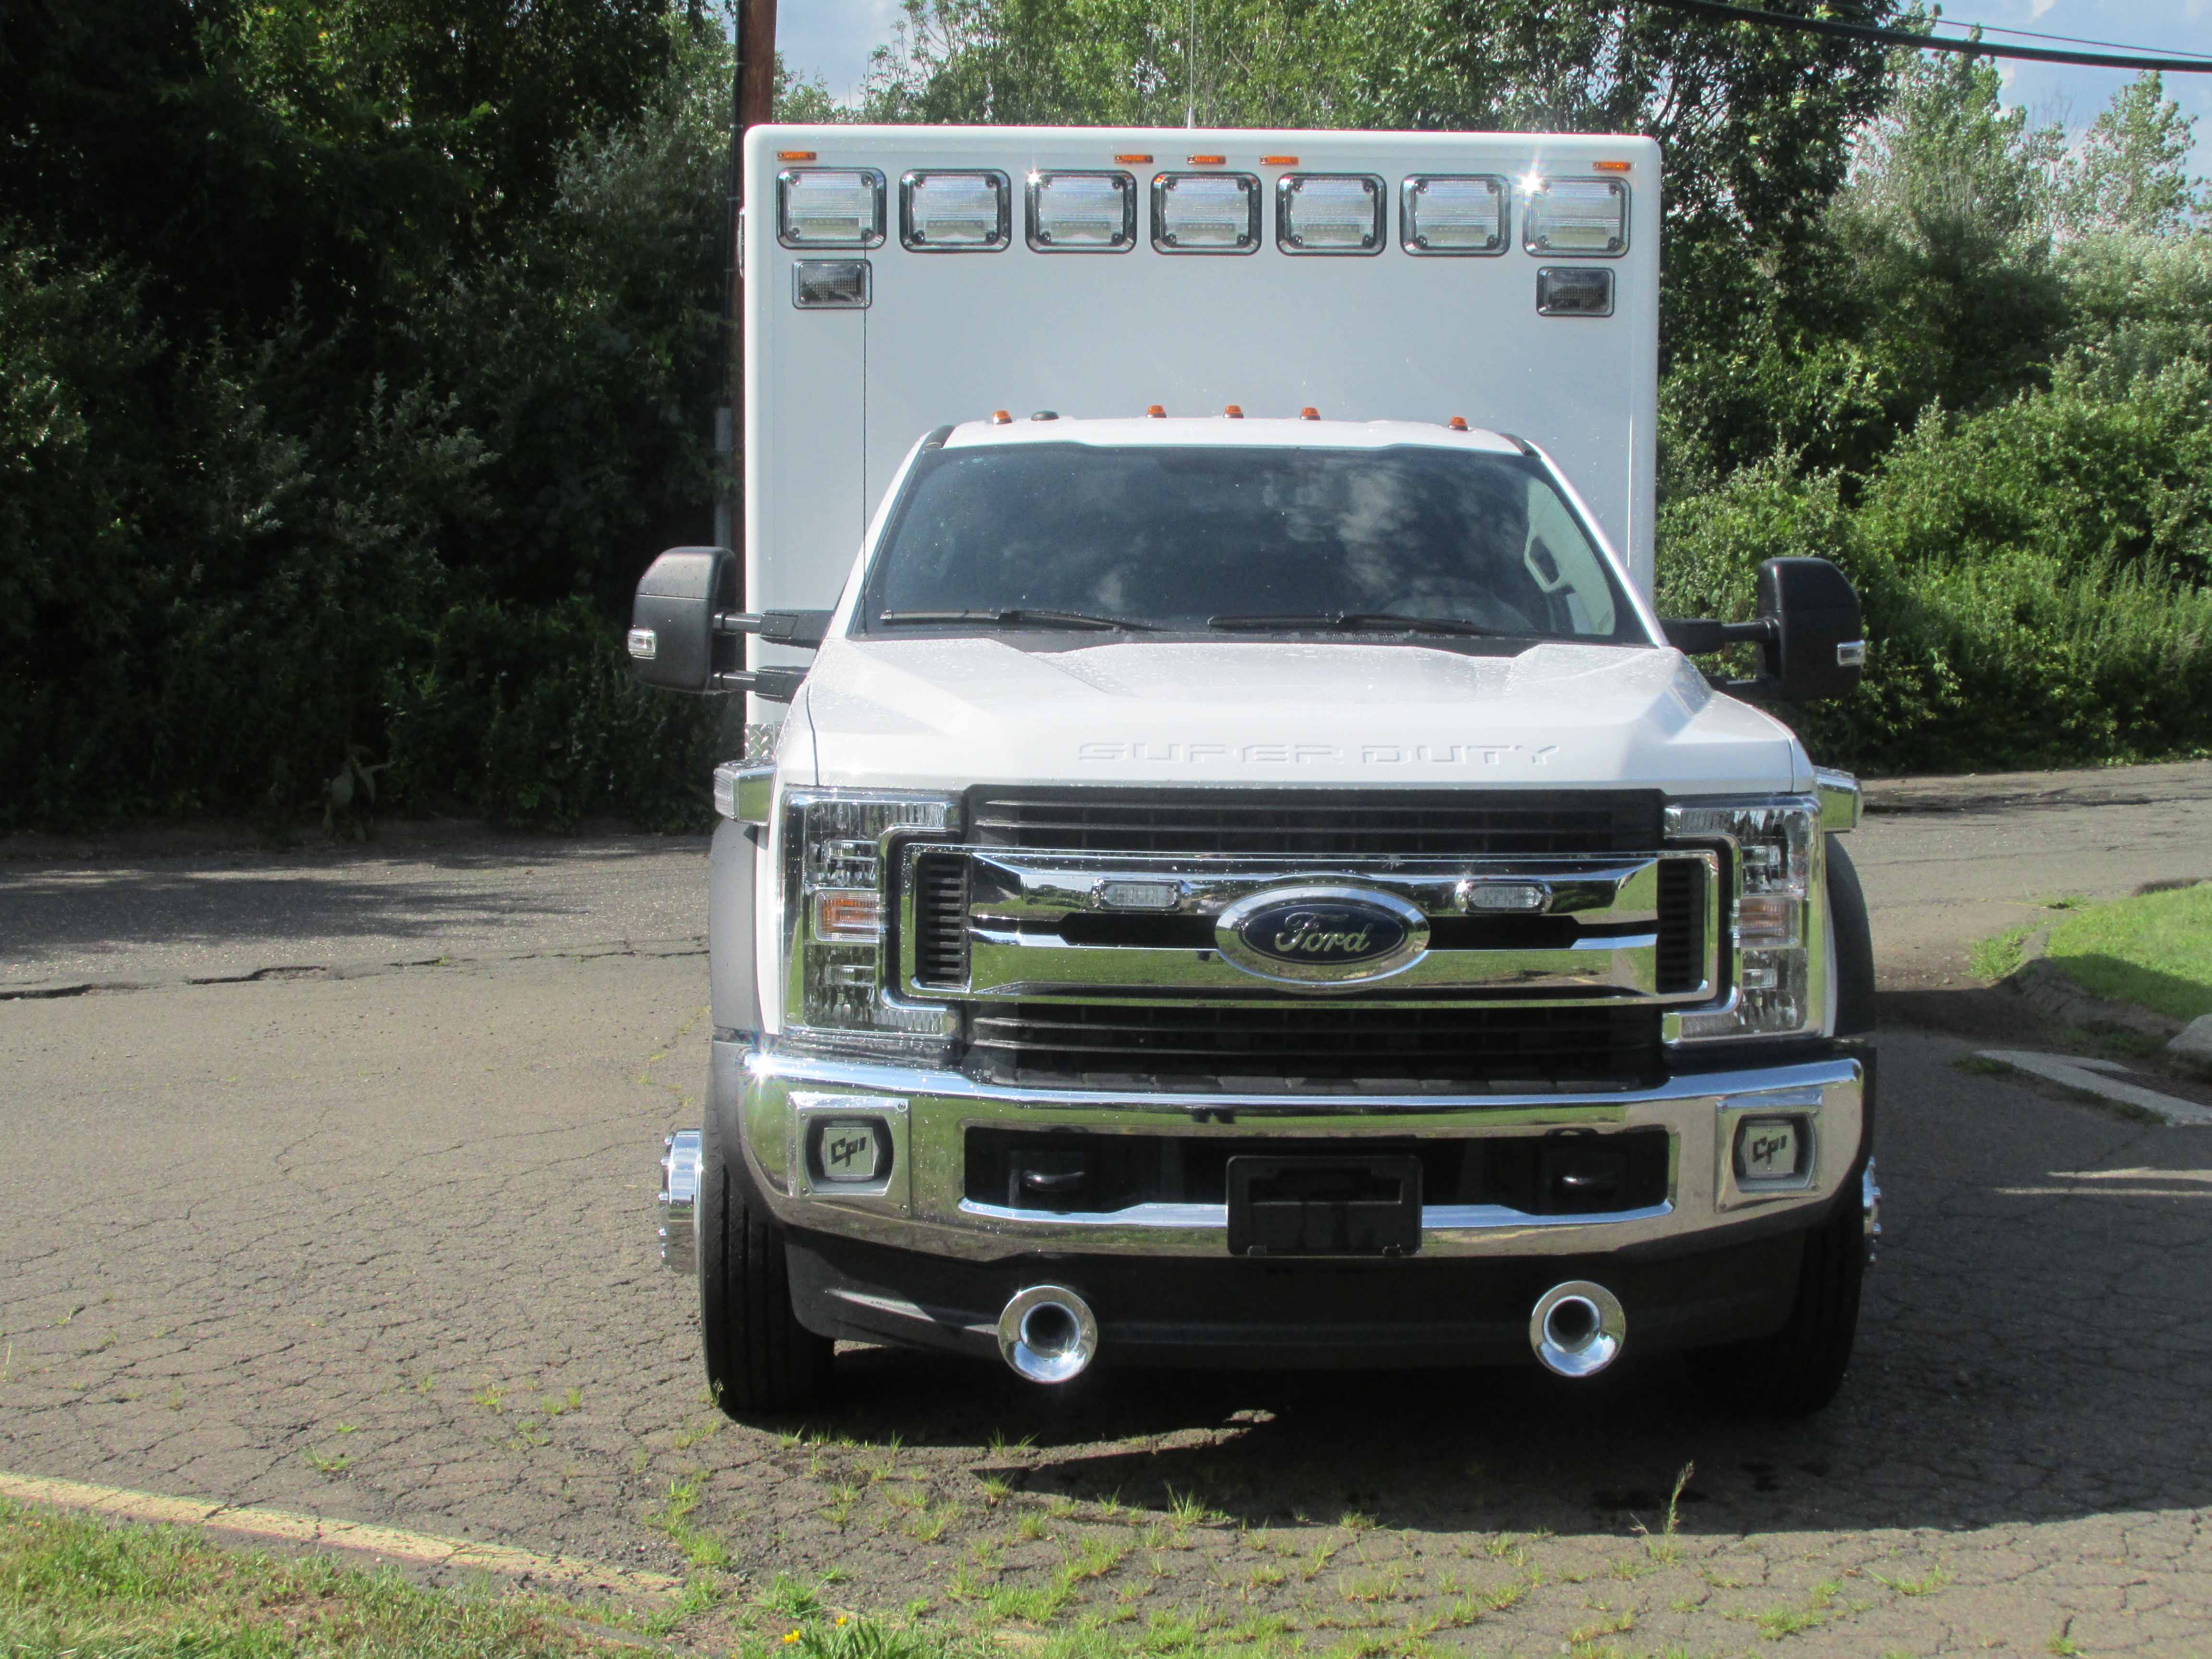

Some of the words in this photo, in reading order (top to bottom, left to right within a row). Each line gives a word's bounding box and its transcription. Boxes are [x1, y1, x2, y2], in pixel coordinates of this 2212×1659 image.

[1078, 742, 1344, 764] SUPER
[1361, 744, 1560, 765] DUTY
[1274, 912, 1374, 953] Ford
